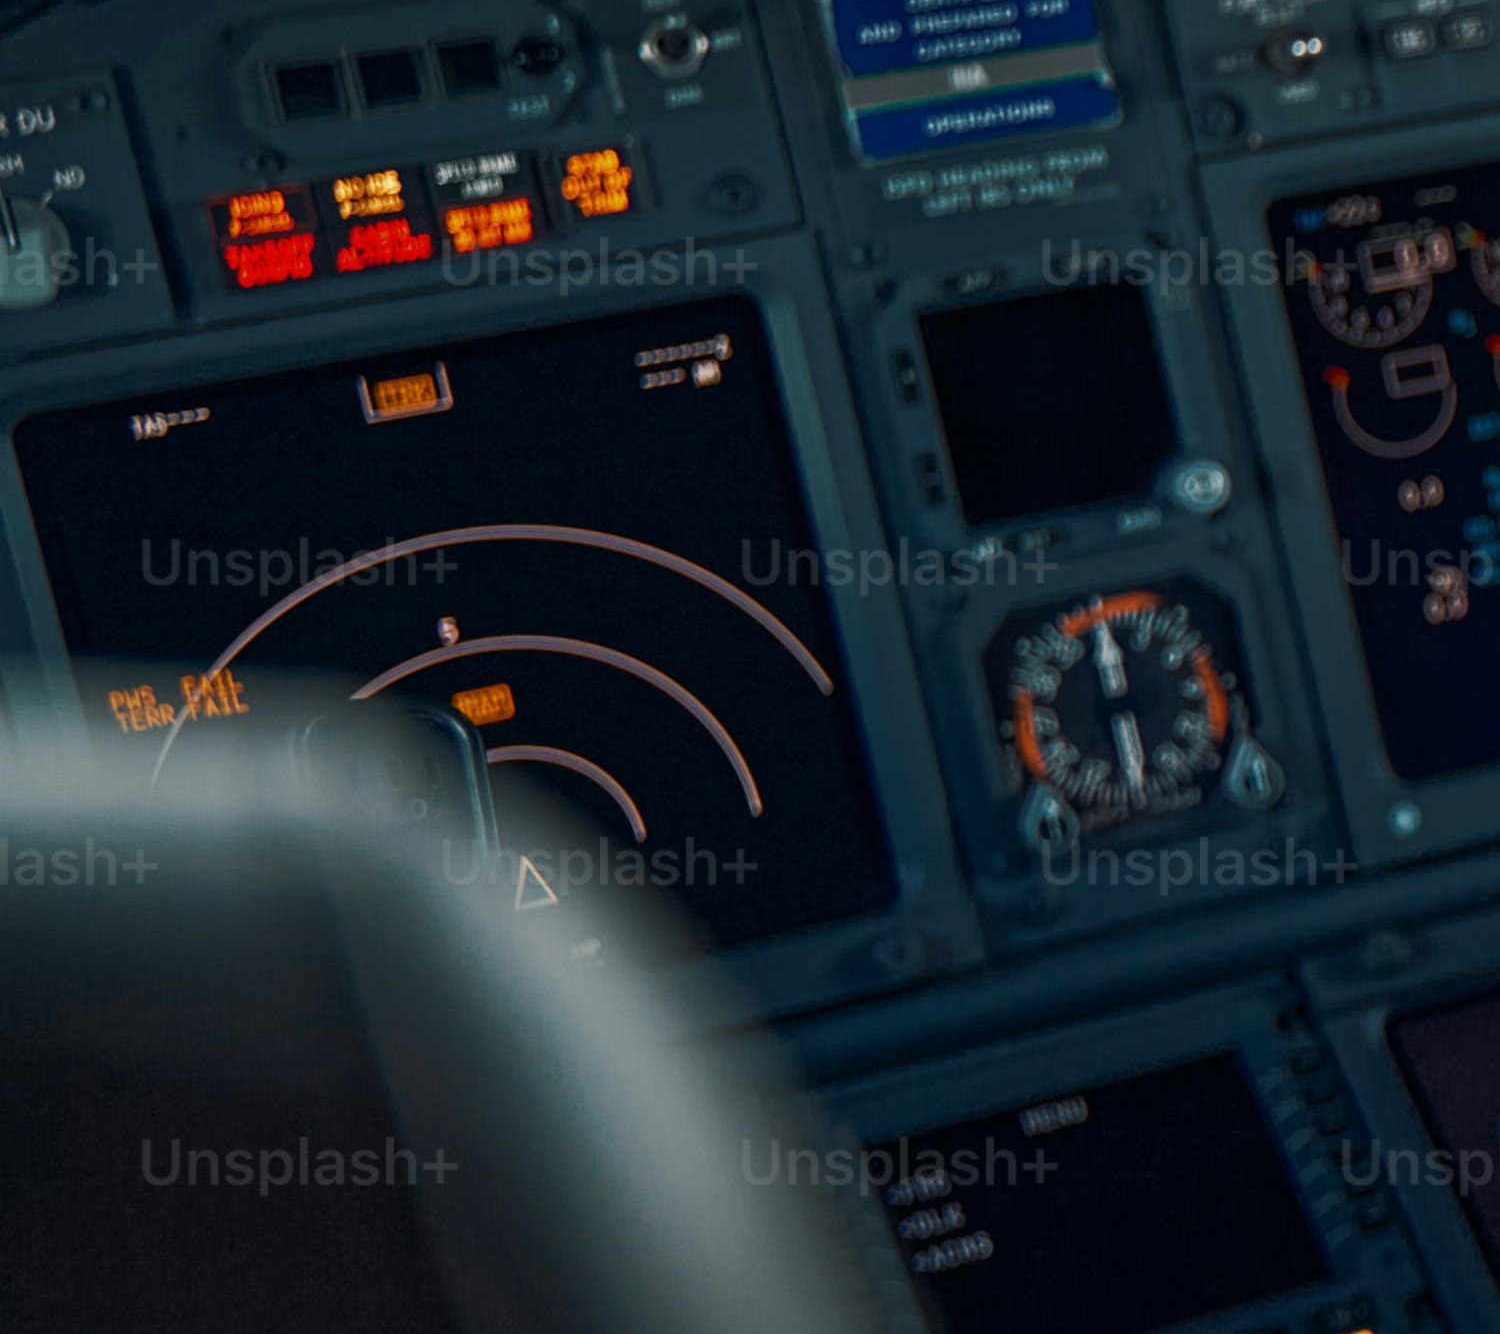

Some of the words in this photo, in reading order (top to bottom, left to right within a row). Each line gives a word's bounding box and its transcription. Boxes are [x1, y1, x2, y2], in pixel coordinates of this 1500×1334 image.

[16, 104, 56, 137] DU
[921, 95, 1057, 139] OPERATIONS
[53, 164, 86, 191] ND
